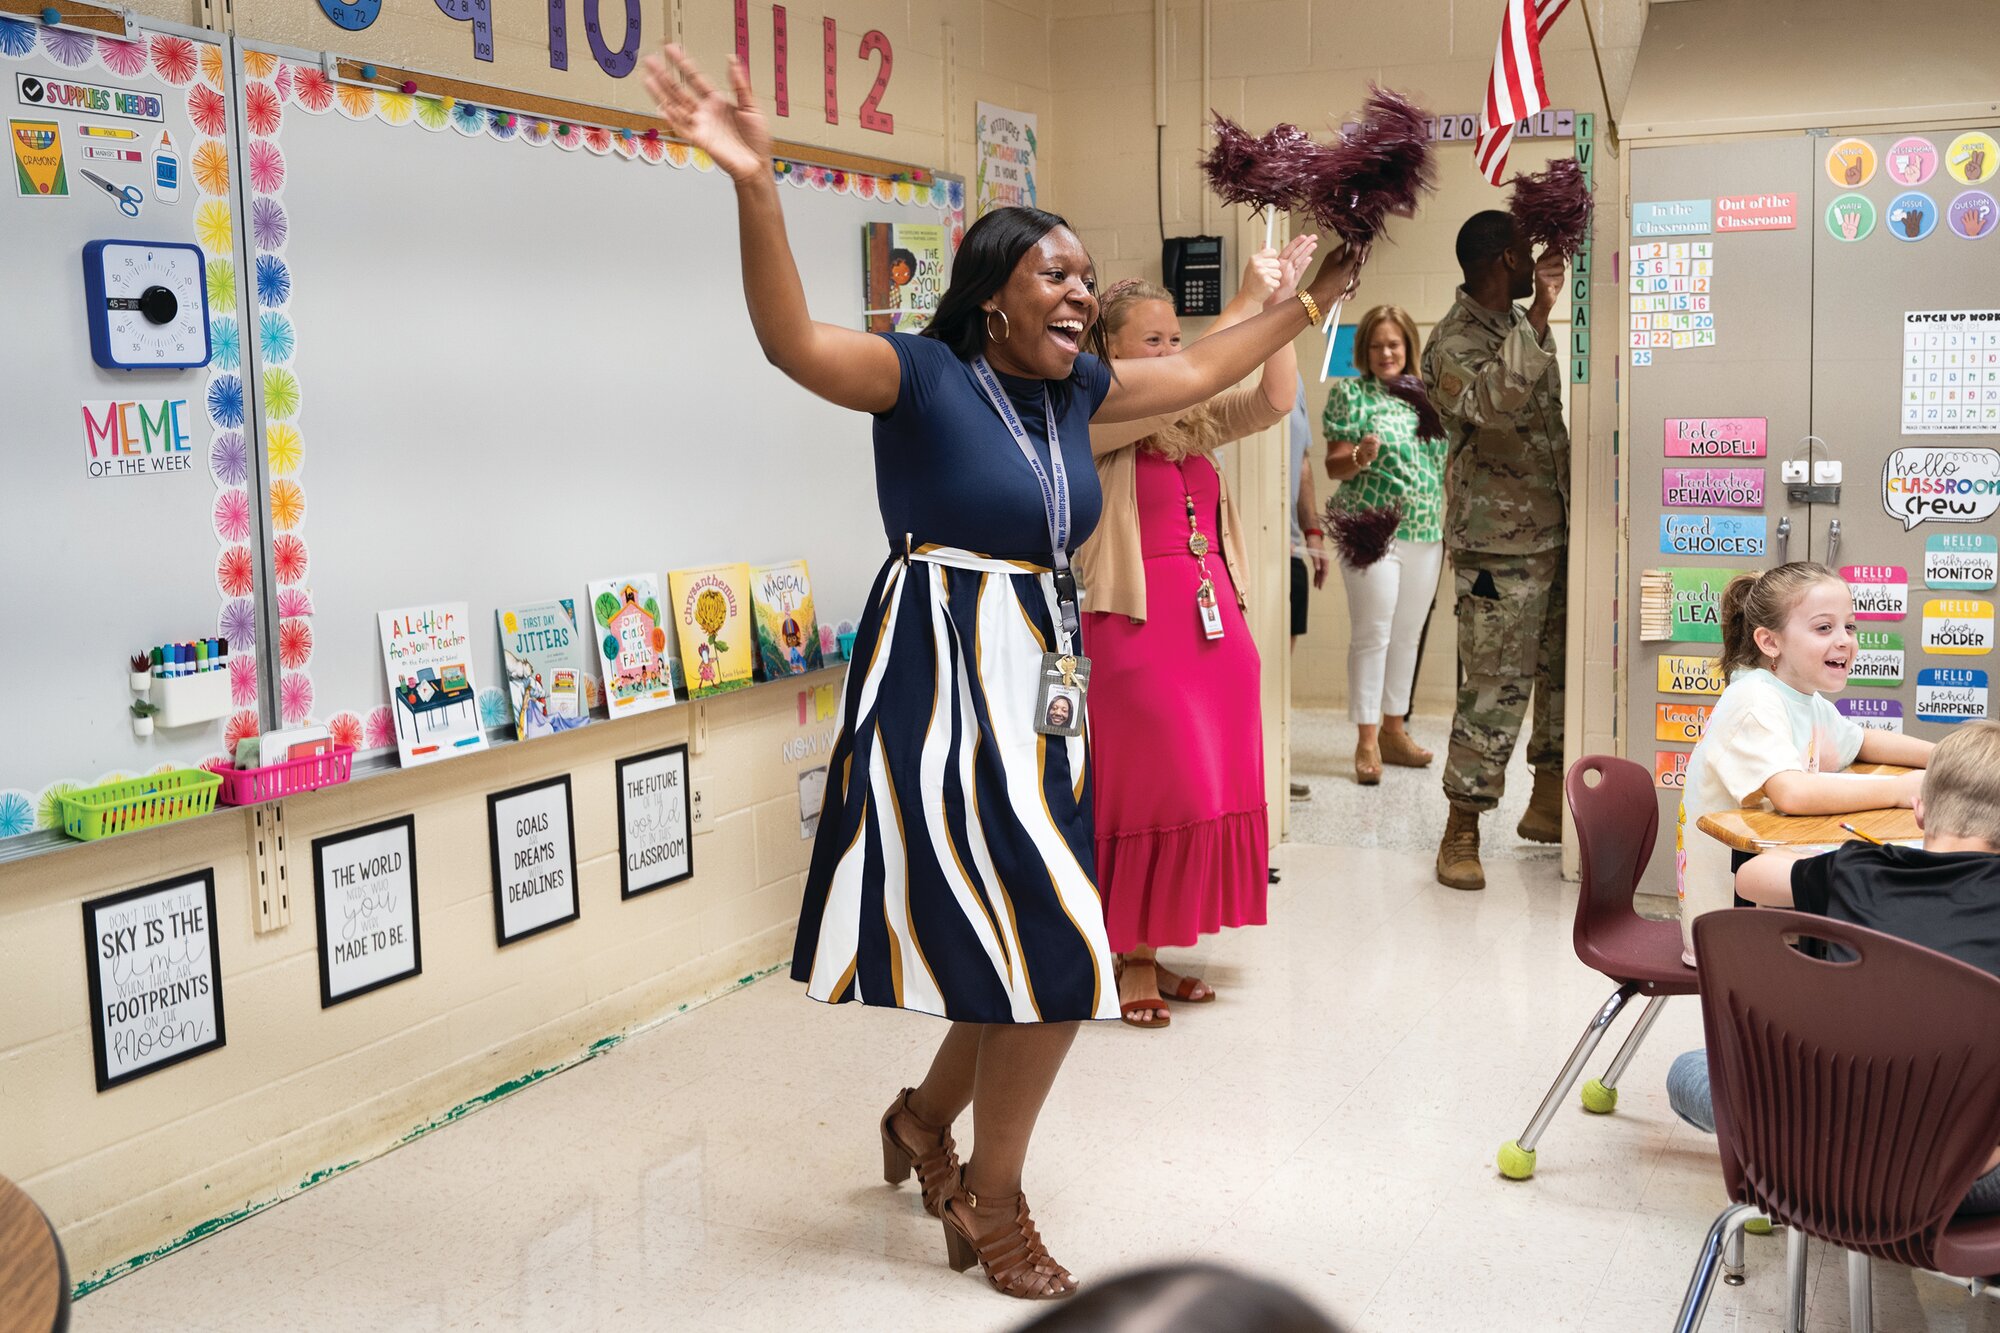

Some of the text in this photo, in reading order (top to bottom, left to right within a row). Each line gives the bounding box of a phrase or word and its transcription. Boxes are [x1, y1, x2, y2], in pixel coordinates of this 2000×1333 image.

[332, 8, 345, 21] 64
[354, 9, 366, 23] 72
[476, 21, 486, 33] 99
[478, 43, 490, 55] 108
[823, 17, 893, 134] 12
[46, 82, 161, 118] SUPPLIES NEEDED
[22, 155, 57, 166] CRAYONS
[1652, 202, 1693, 217] In the
[1718, 195, 1790, 212] Out of the
[1901, 200, 1922, 208] TISSUE
[1954, 199, 1990, 210] QUESTION
[1636, 220, 1709, 234] Classroom
[1716, 214, 1792, 228] Classroom
[924, 248, 939, 259] THE
[1638, 247, 1642, 259] 1
[1653, 244, 1662, 257] 2
[1676, 245, 1683, 258] 3
[1698, 244, 1706, 256] 4
[124, 258, 134, 266] 55
[919, 260, 940, 276] DAY
[1637, 262, 1645, 276] 5
[1655, 262, 1662, 274] 6
[1676, 262, 1683, 274] 7
[1699, 261, 1706, 274] 8
[112, 274, 121, 282] 50
[184, 277, 192, 286] 10
[1636, 279, 1644, 291] 9
[1654, 278, 1668, 290] 10
[1674, 279, 1683, 291] 11
[916, 277, 940, 294] YOU
[1692, 280, 1706, 292] 12
[110, 300, 118, 308] 45
[191, 302, 199, 310] 15
[1634, 298, 1646, 310] 13
[1653, 298, 1666, 310] 14
[1674, 296, 1687, 308] 15
[1693, 298, 1706, 310] 16
[1635, 316, 1647, 328] 17
[1656, 316, 1669, 328] 18
[1676, 316, 1689, 328] 19
[1696, 316, 1712, 327] 20
[1907, 314, 1948, 322] CATCH
[1950, 313, 1966, 322] UP
[116, 325, 126, 334] 40
[188, 326, 196, 334] 20
[1634, 334, 1646, 345] 21
[1653, 332, 1670, 344] 22
[1675, 334, 1690, 345] 23
[1698, 332, 1713, 343] 24
[132, 344, 140, 352] 35
[156, 350, 164, 358] 30
[176, 344, 184, 352] 25
[1634, 352, 1650, 364] 25
[82, 400, 191, 458] MEME
[1679, 420, 1719, 439] Role
[1691, 440, 1755, 455] MODEL!
[90, 455, 192, 476] OF THE WEEK
[1895, 451, 1960, 478] hello
[1887, 477, 2000, 496] CLASSROOM
[1668, 488, 1760, 503] BEHAVIOR!
[1056, 462, 1066, 549] www.sumterschools.net
[1666, 515, 1714, 541] Good
[1674, 537, 1764, 553] CHOICES!
[1943, 535, 1982, 547] HELLO
[1932, 554, 1992, 568] bathroom
[1854, 566, 1892, 578] HELLO
[763, 574, 806, 602] MAGICAL
[1852, 584, 1892, 600] lunch
[684, 574, 738, 625] chrysanthemum
[775, 590, 795, 611] YET
[1853, 599, 1903, 612] ANAGER
[1940, 600, 1979, 612] HELLO
[394, 610, 454, 639] A Letter
[522, 614, 555, 629] FIRST DAY
[1940, 618, 1976, 634] door
[390, 642, 409, 660] from
[428, 630, 466, 650] Teacher
[516, 628, 569, 654] JITTERS
[1858, 633, 1889, 645] ELLO
[1930, 632, 1984, 646] HOLDER
[624, 648, 652, 666] FAMILY
[1667, 659, 1709, 676] Think
[1934, 669, 1973, 681] HELLO
[1930, 688, 1974, 702] pencil
[1850, 700, 1888, 711] HELLO
[1918, 702, 1984, 714] SHARPENER
[627, 770, 678, 798] THE FUTURE
[628, 796, 680, 839] world
[516, 812, 548, 838] GOALS
[640, 834, 646, 848] IS
[648, 832, 656, 845] IN
[514, 842, 554, 870] DREAMS
[628, 838, 686, 872] CLASSROOM.
[332, 852, 402, 889] THE WORLD
[346, 878, 388, 903] NEEDS WHO
[508, 869, 564, 904] DEADLINES
[110, 892, 192, 930] DON'T TELL ME THE
[342, 892, 397, 941] you
[102, 906, 204, 959] SKY IS THE
[335, 924, 408, 965] MADE TO BE.
[112, 936, 206, 986] limit
[116, 964, 192, 1000] WHEN THERE ARE
[108, 974, 209, 1027] FOOTPRINTS
[144, 1008, 176, 1031] ON THE
